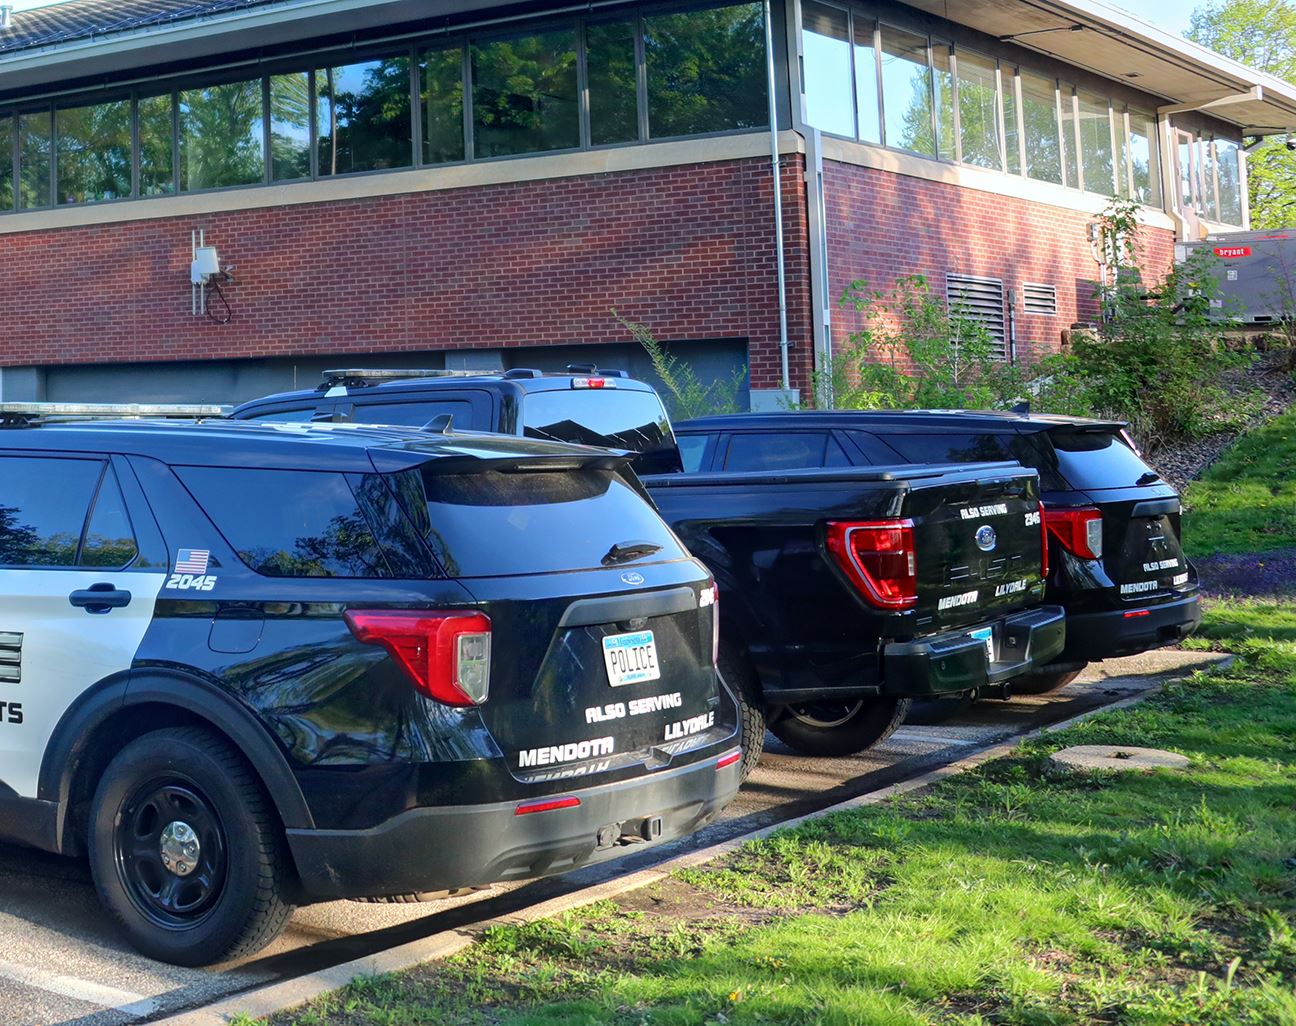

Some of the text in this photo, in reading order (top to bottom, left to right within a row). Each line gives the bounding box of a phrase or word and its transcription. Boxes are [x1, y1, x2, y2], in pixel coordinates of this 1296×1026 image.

[1218, 248, 1245, 257] bryant
[960, 503, 1008, 520] ALSO SERVING
[165, 573, 218, 591] 2045
[994, 579, 1028, 598] LILYDALE
[1120, 580, 1158, 595] MENDOTA
[937, 590, 979, 611] MENDOTA
[610, 645, 655, 675] POLICE
[585, 692, 683, 724] ALSO SERVING
[664, 711, 715, 741] LILYDALE
[518, 736, 615, 768] MENDOTA
